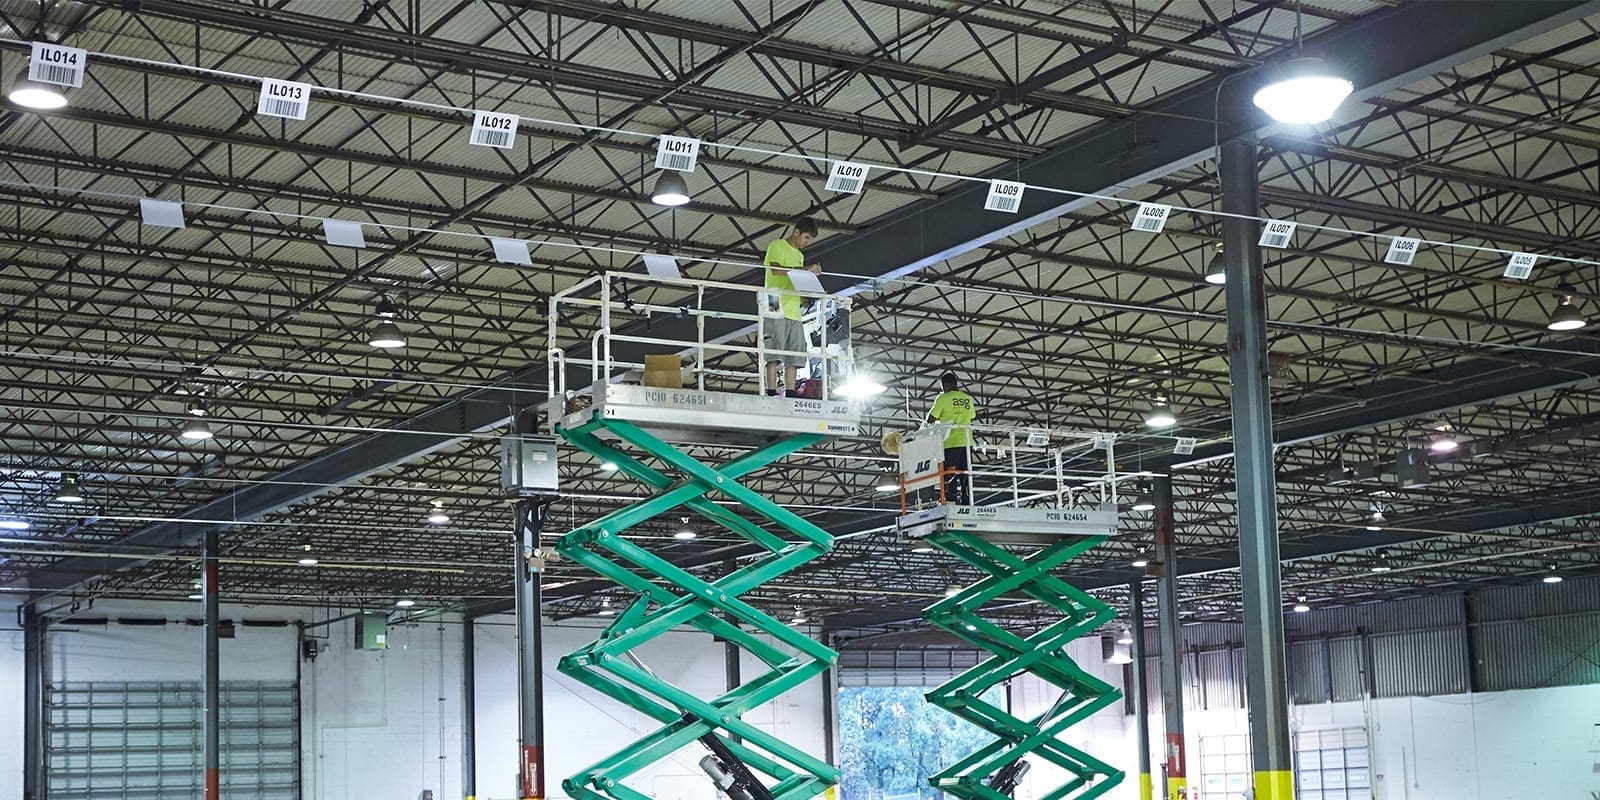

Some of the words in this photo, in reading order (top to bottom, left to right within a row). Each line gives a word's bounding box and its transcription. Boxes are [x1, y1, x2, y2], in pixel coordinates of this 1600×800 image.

[40, 47, 78, 65] IL014
[268, 83, 303, 99] IL013
[480, 115, 512, 130] IL012
[665, 139, 693, 154] IL011
[836, 165, 863, 178] IL010
[994, 183, 1018, 196] IL009
[1142, 206, 1166, 218] IL008
[1269, 223, 1291, 235] IL007
[1394, 240, 1414, 251] IL006
[673, 393, 706, 405] 624651
[794, 400, 823, 410] 2646ES
[952, 398, 971, 410] asg
[831, 405, 849, 415] JLG
[914, 459, 931, 474] JLG
